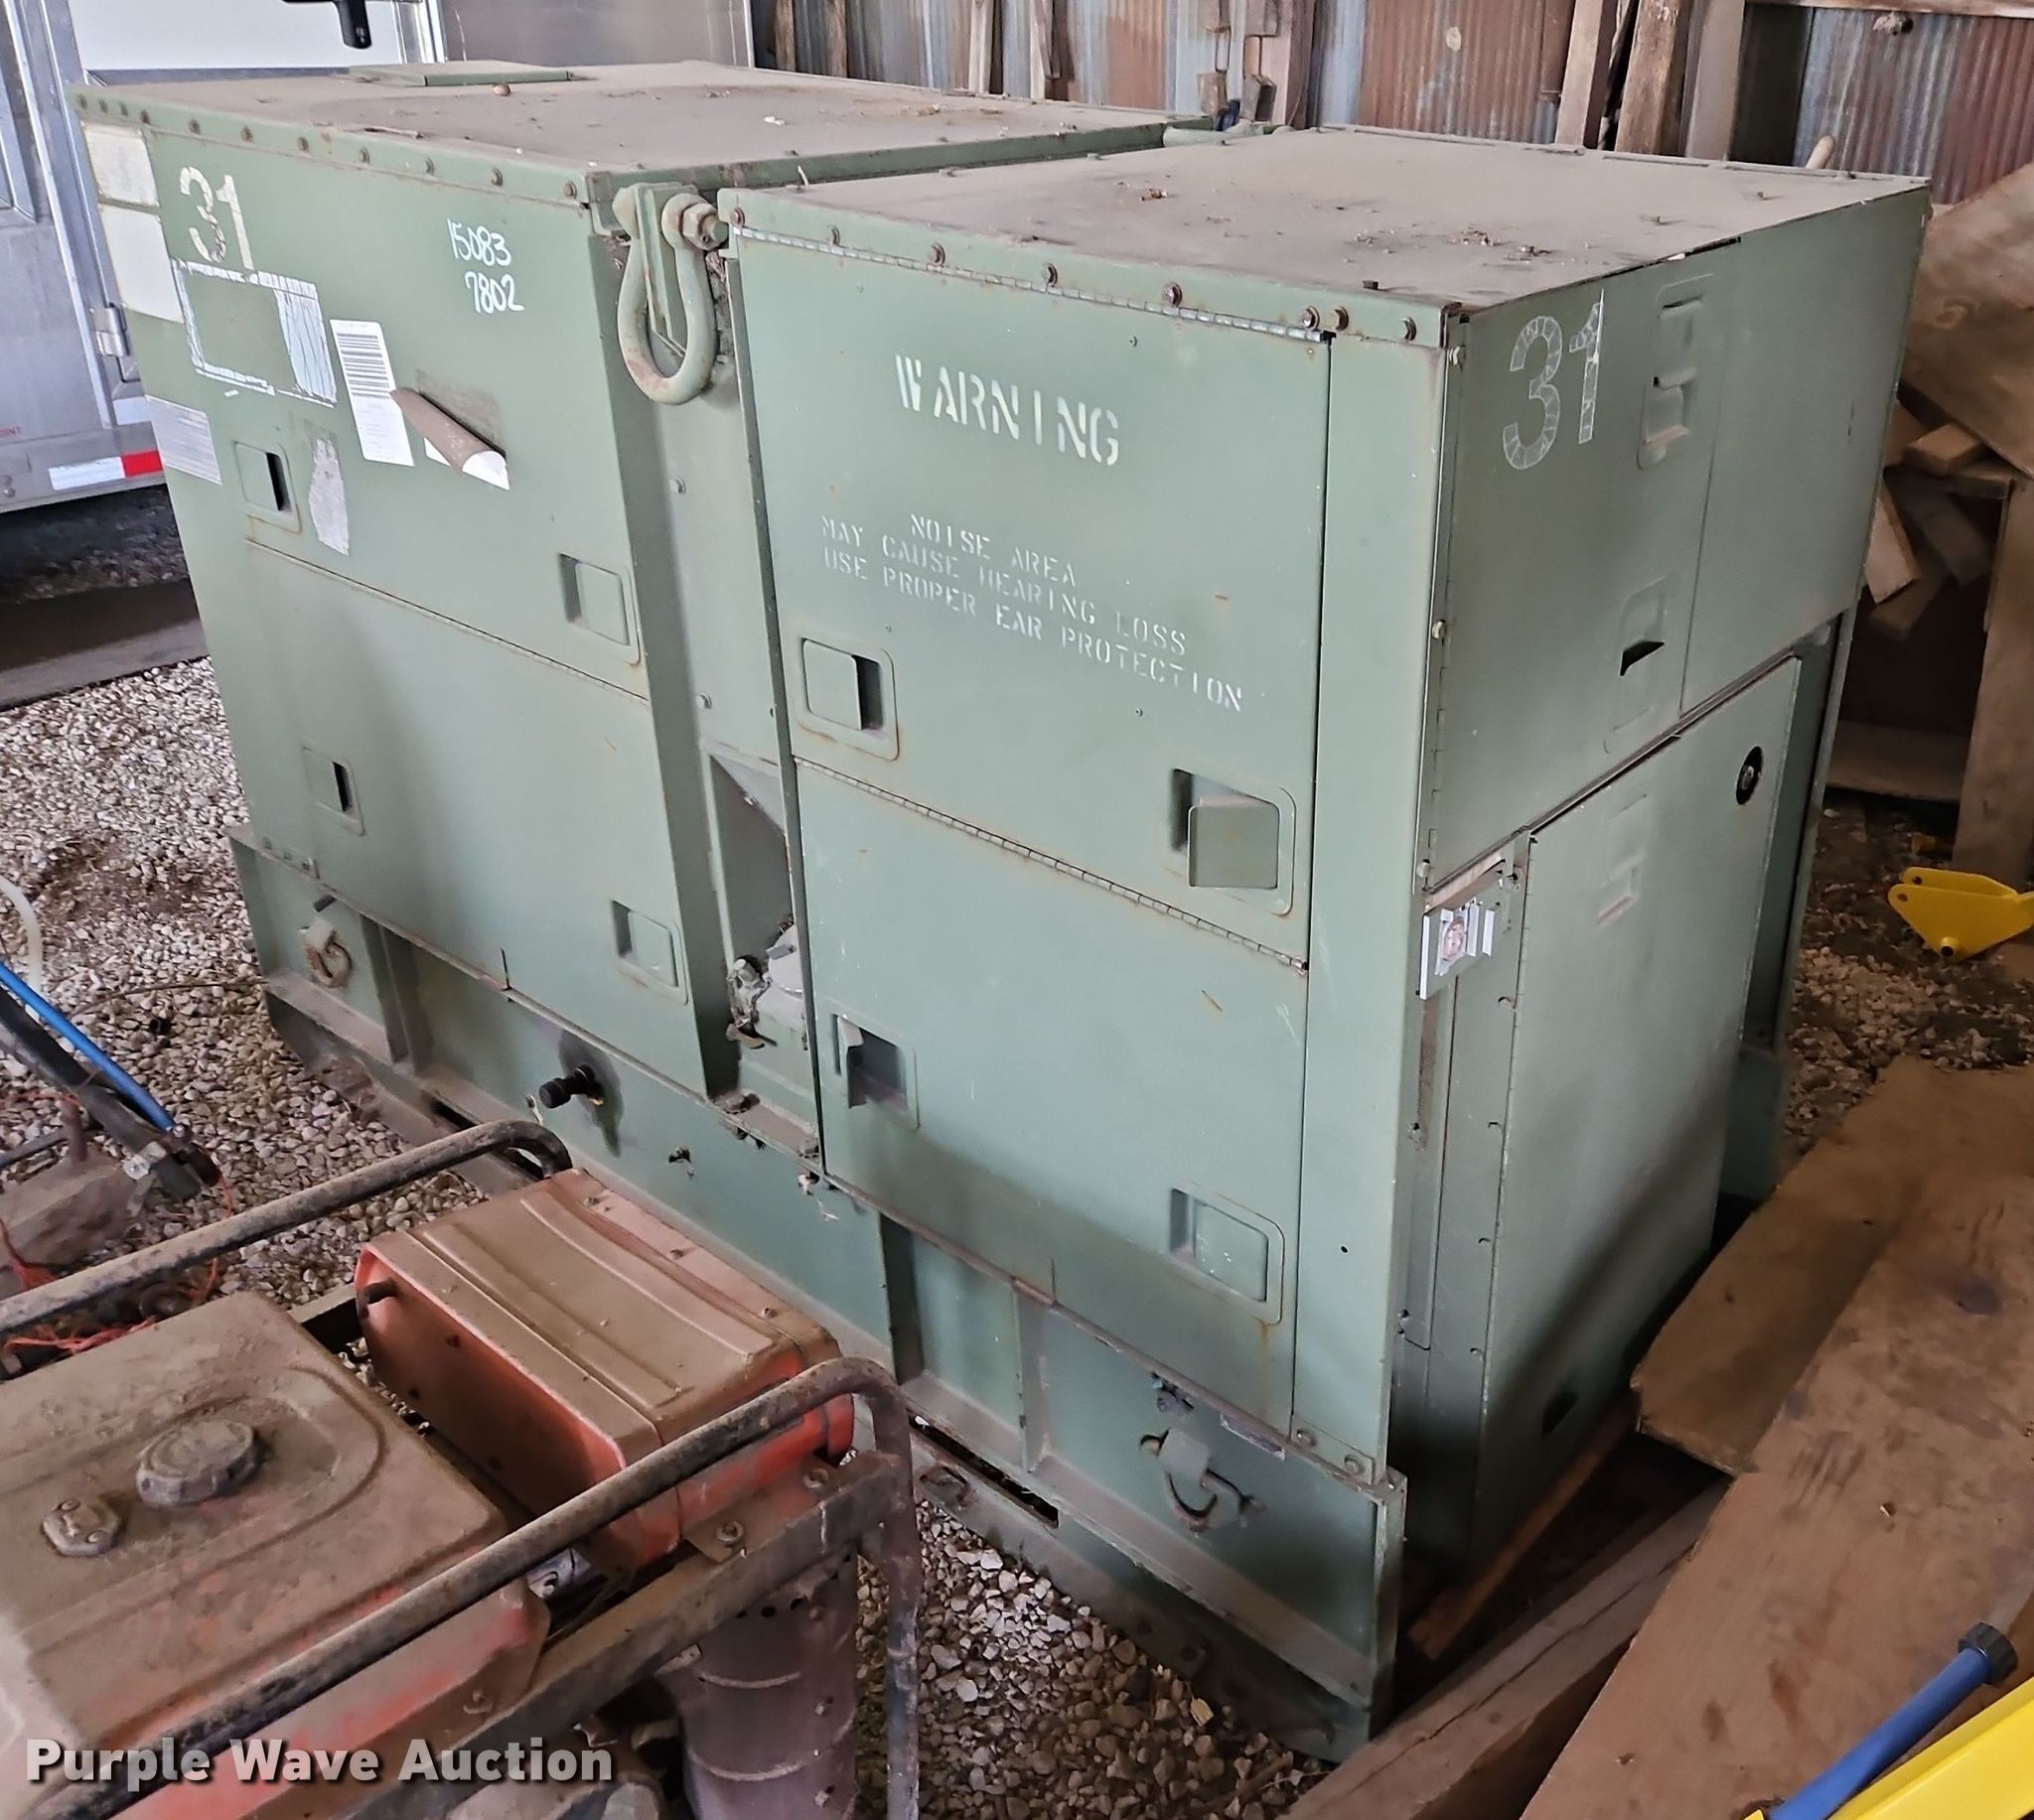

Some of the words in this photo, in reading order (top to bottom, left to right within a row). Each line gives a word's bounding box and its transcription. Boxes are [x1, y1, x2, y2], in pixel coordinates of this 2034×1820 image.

[180, 166, 252, 269] 31
[446, 217, 513, 267] 15083
[464, 272, 524, 314] 7802
[895, 354, 1119, 467] WARNING
[1503, 288, 1605, 471] 31
[821, 515, 864, 548] MAY
[882, 534, 959, 578] CAUSE
[979, 565, 1095, 626] HEARING
[1116, 611, 1187, 656] LOSS
[910, 513, 991, 560] NOISE
[1010, 547, 1077, 588] AREA
[823, 548, 868, 581] USE
[884, 565, 976, 618] PROPER
[996, 605, 1043, 641] EAR
[1062, 630, 1242, 713] PROTECTION
